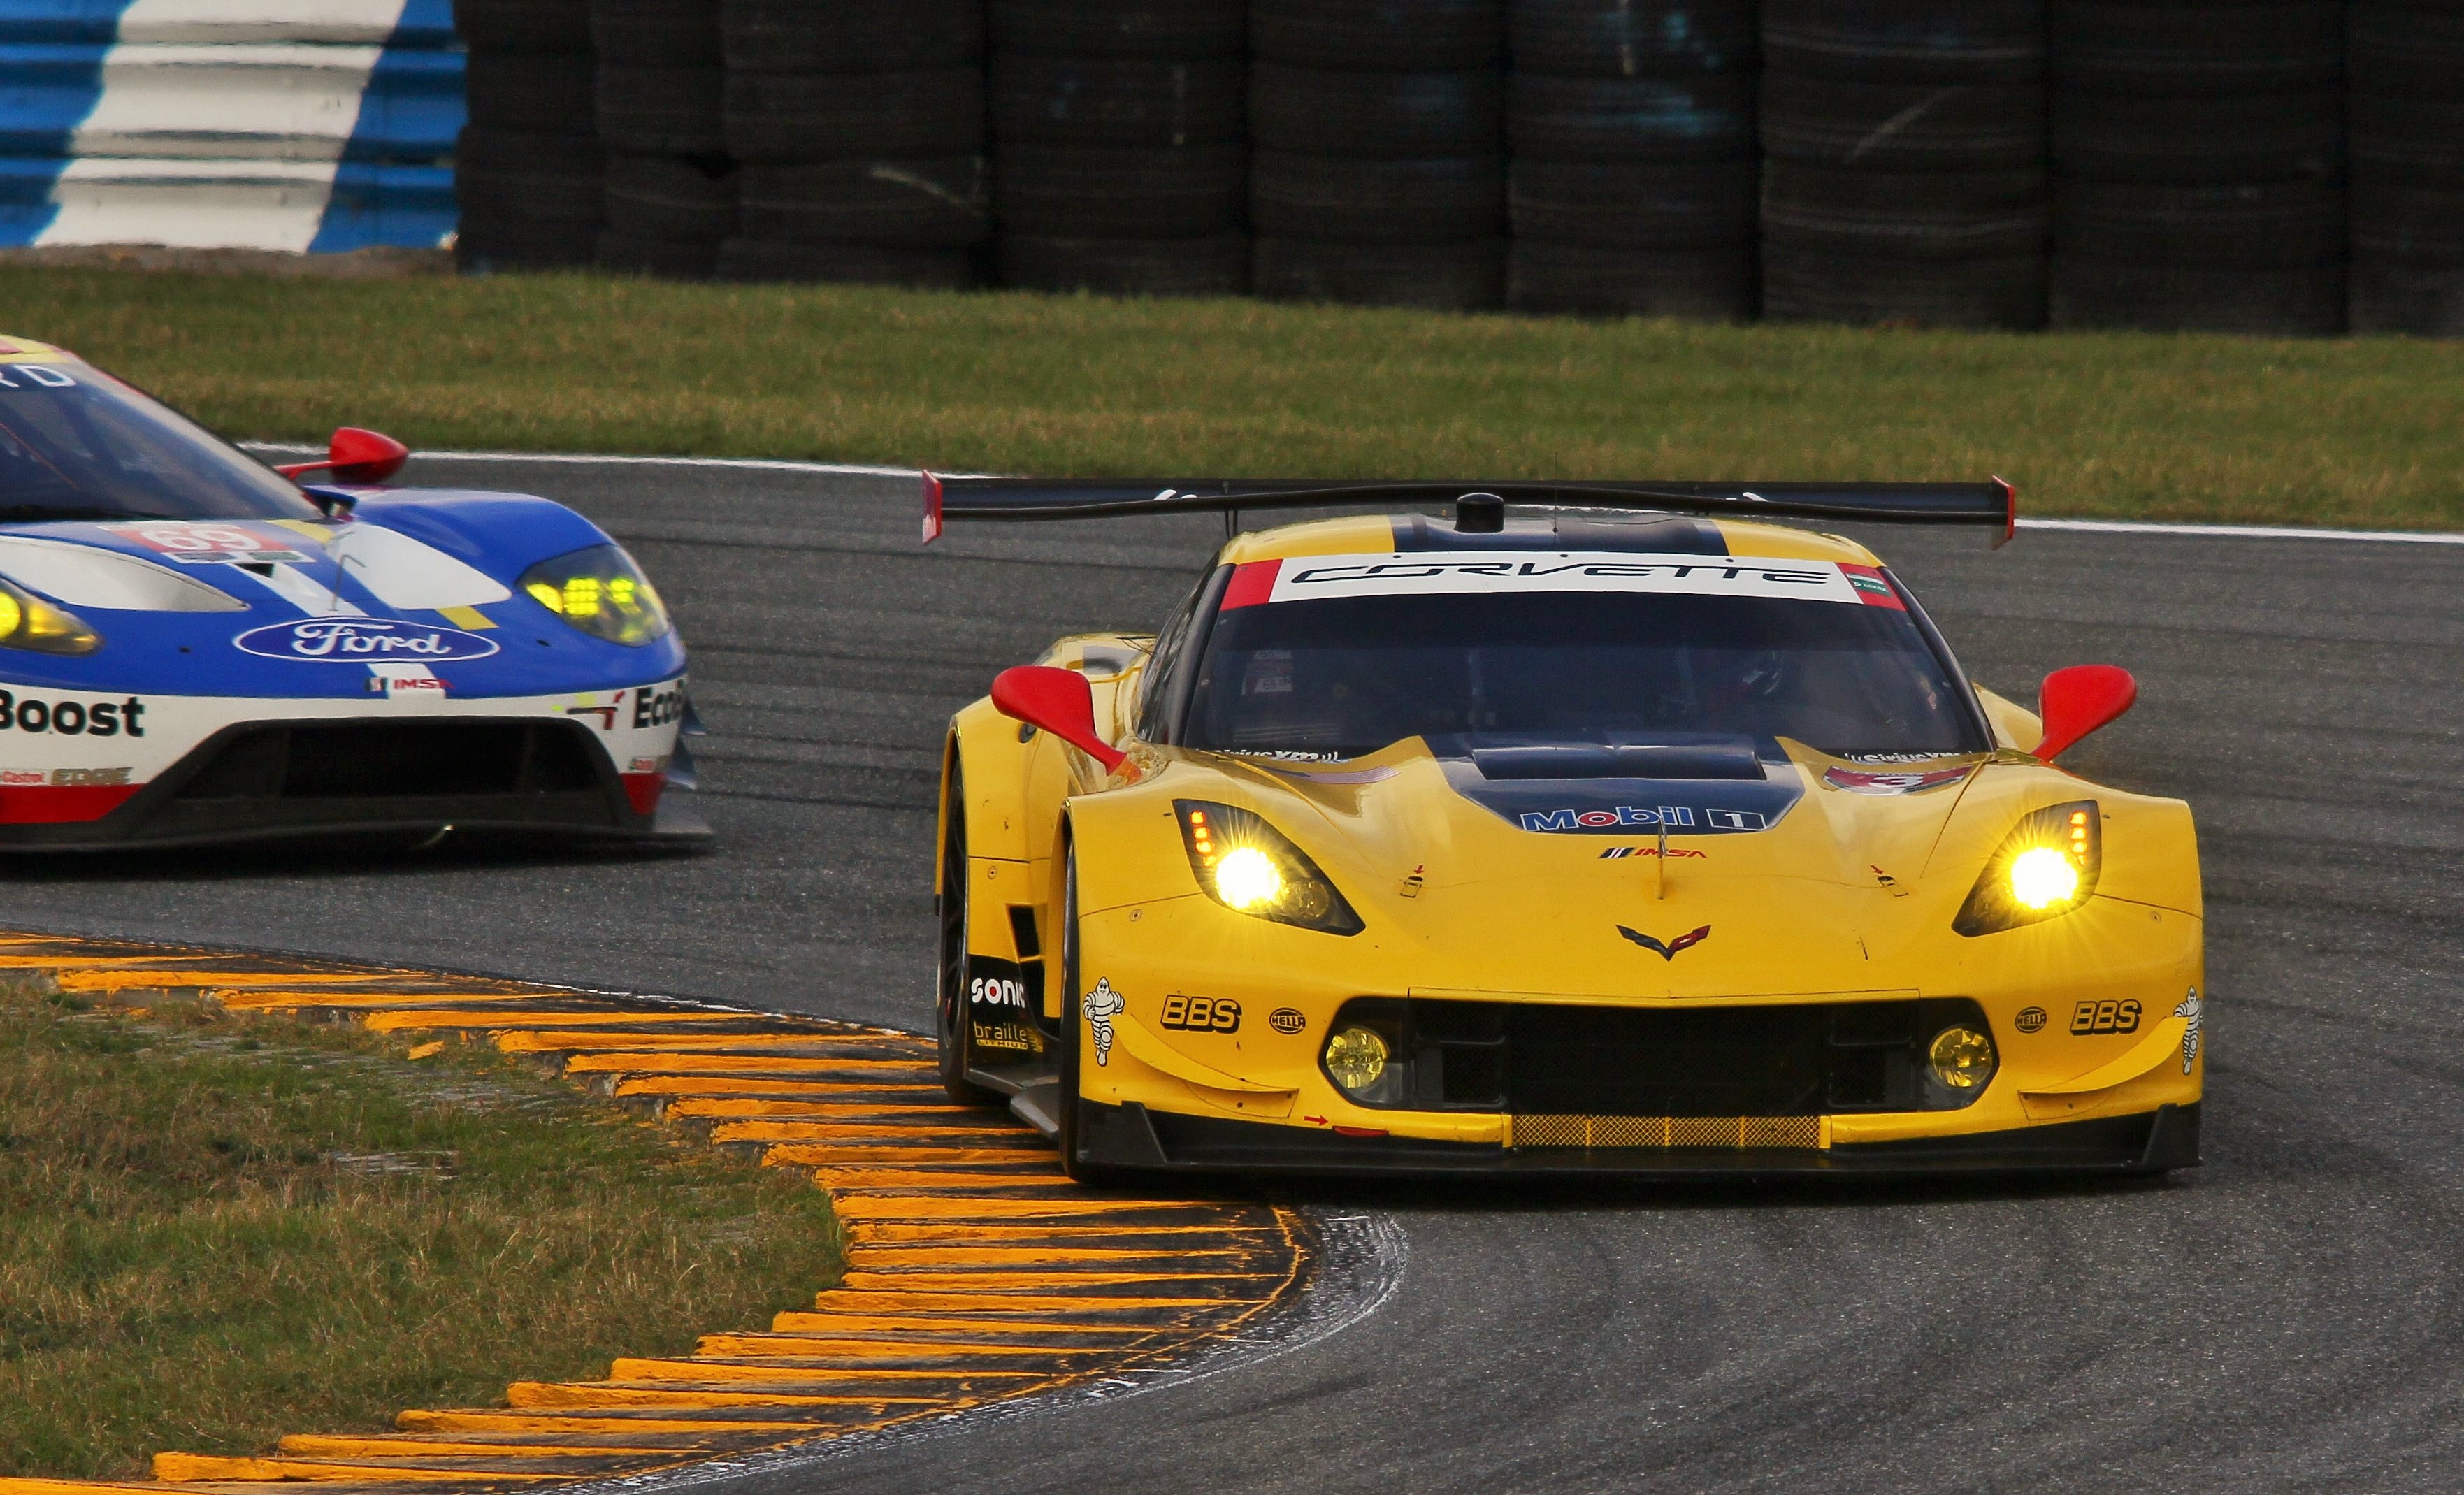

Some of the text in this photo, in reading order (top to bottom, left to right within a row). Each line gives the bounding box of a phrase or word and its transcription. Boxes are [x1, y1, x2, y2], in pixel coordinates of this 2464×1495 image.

[141, 529, 261, 551] 69
[1291, 563, 1831, 584] CORVETTE
[291, 622, 452, 656] Ford
[394, 678, 456, 690] IMSA
[1868, 776, 1924, 788] 3
[1520, 806, 1696, 831] Mobil
[1634, 848, 1708, 859] IMSA
[1160, 995, 1243, 1034] BBS
[2069, 999, 2143, 1037] BBS
[974, 1020, 1028, 1041] braille
